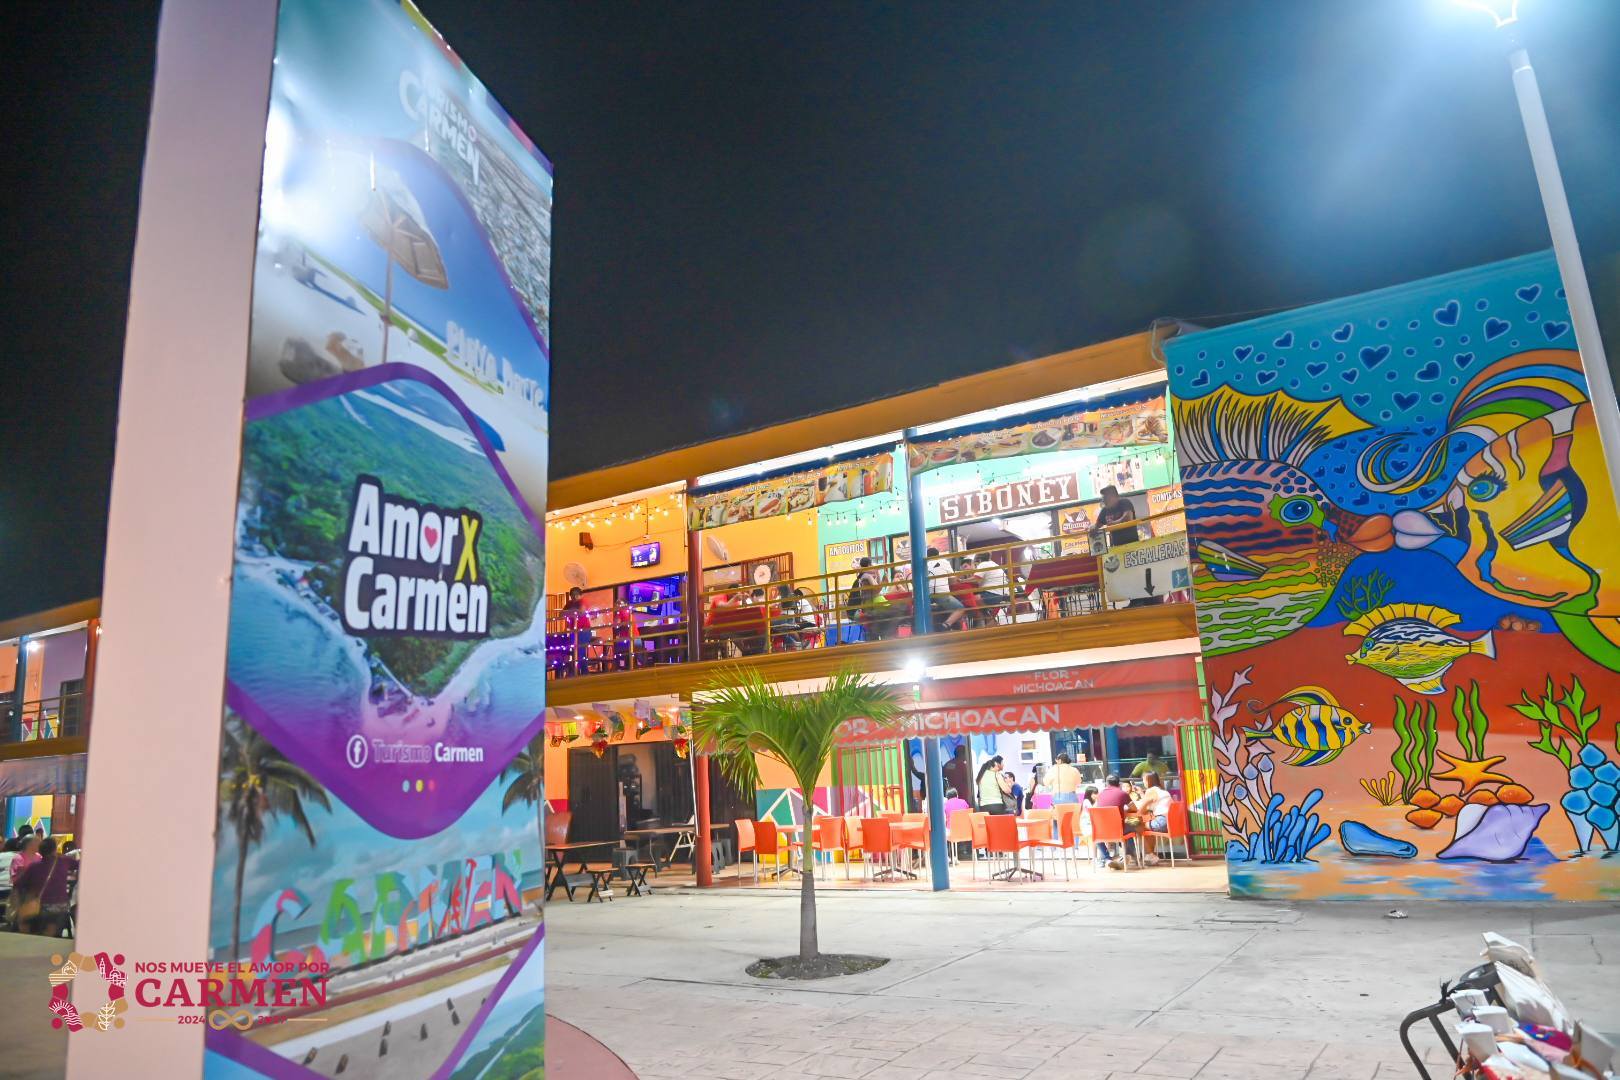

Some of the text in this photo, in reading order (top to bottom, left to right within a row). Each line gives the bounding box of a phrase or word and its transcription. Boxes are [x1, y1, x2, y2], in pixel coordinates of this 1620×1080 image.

[942, 475, 1072, 520] SIBONEY
[348, 482, 459, 566] Amor
[1124, 539, 1185, 568] ESCALERAS
[344, 556, 489, 634] Carmen
[1013, 679, 1094, 694] MICHOACAN
[1034, 669, 1070, 681] FLOR
[900, 703, 1059, 732] MICHOACAN
[371, 739, 432, 763] Turismo
[434, 741, 484, 762] Carmen
